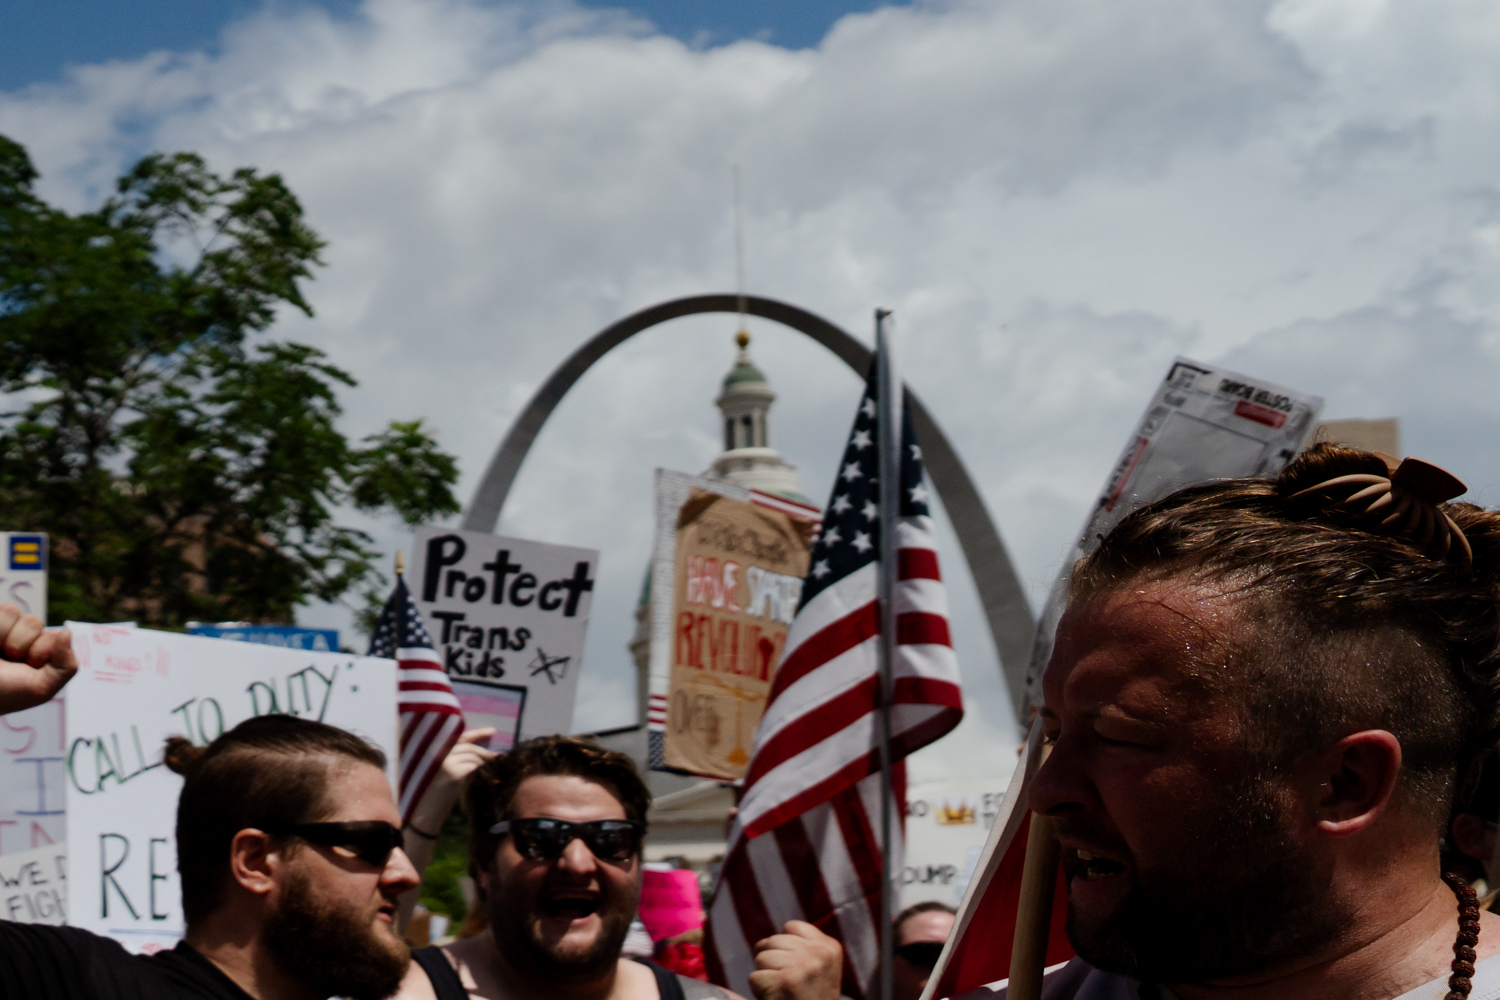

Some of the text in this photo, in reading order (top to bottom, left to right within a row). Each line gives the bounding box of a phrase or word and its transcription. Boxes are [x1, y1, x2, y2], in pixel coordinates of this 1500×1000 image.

[423, 533, 595, 617] Protect
[431, 611, 532, 652] Trans
[444, 646, 505, 678] Kids
[66, 724, 164, 794] CALL
[170, 696, 225, 747] TO
